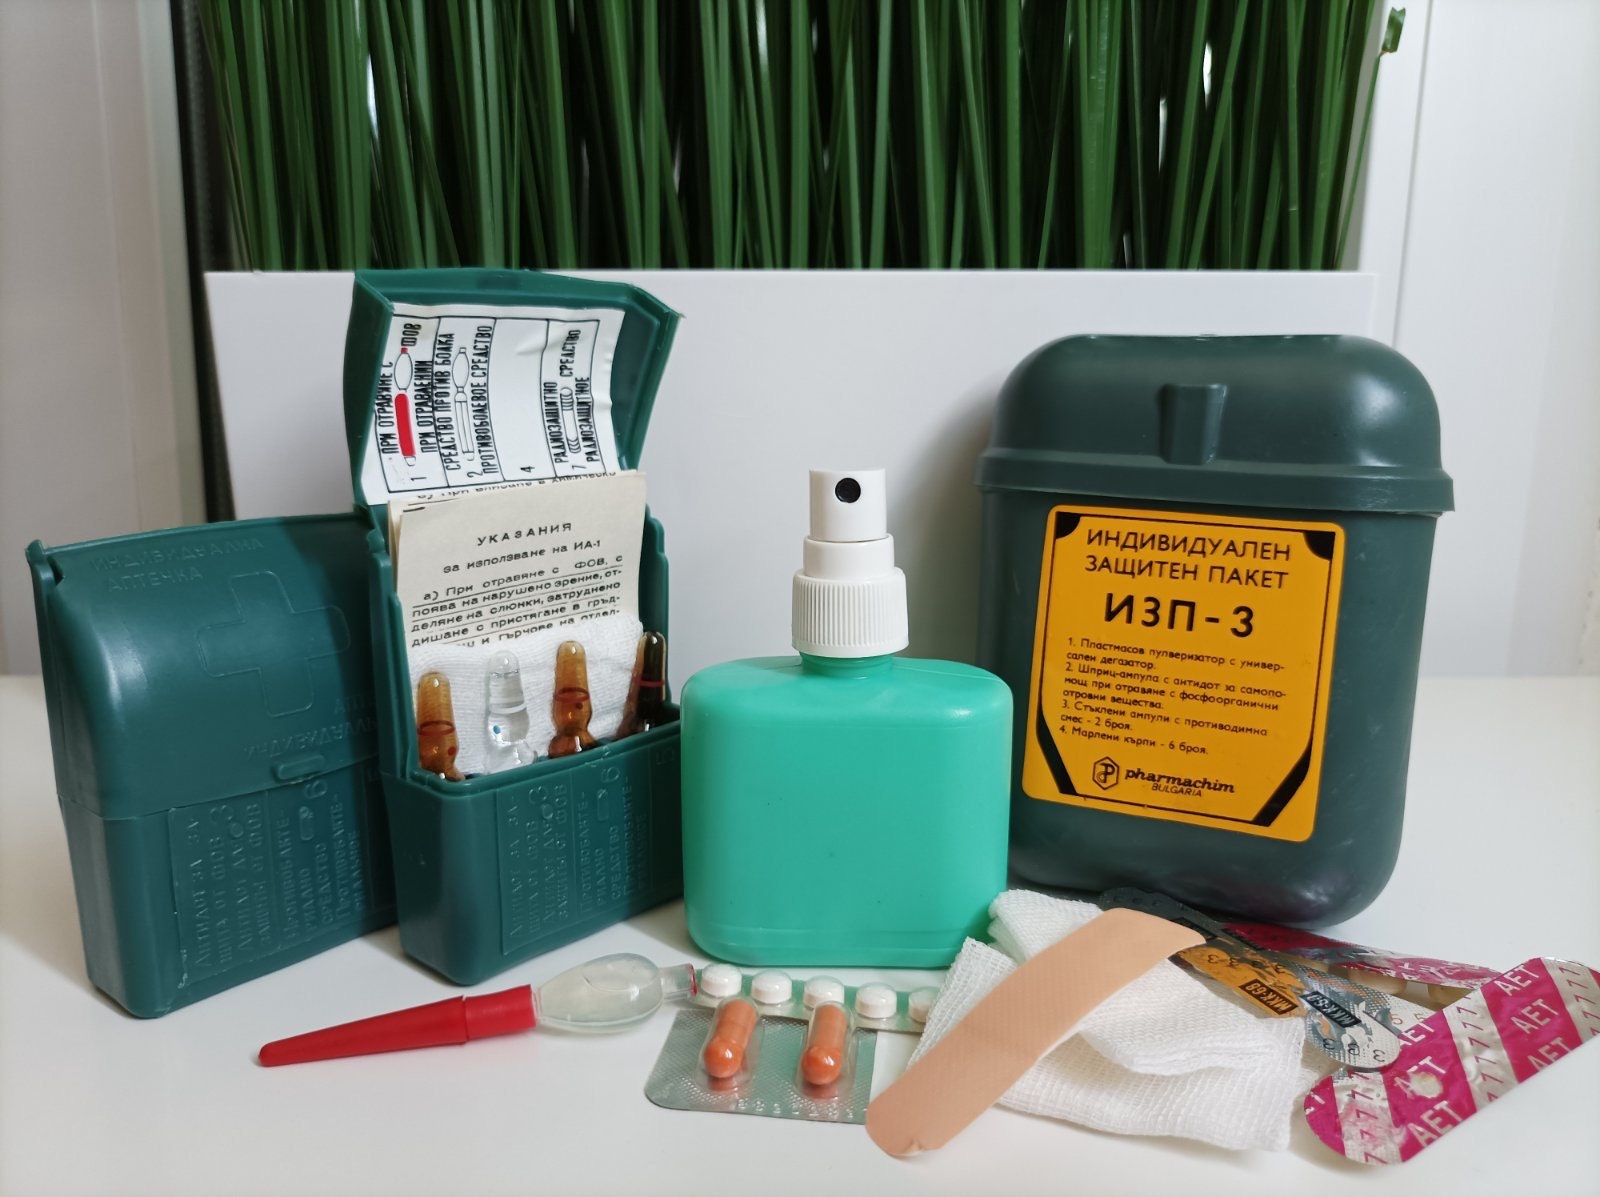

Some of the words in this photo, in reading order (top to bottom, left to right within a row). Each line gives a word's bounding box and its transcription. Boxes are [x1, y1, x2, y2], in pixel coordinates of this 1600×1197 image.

[435, 333, 455, 366] БОЛКА
[471, 325, 493, 378] СРЕДСТВО
[559, 329, 582, 377] СРЕДСТВО
[414, 360, 435, 428] ОТРАВЛЕНИИ
[434, 370, 452, 412] ПРОТИВ
[470, 381, 499, 474] ПРОТИВОБОЛЕВОЕ
[543, 381, 569, 464] РАДИОЗАЩИТНО
[575, 376, 601, 463] РАДИОЗАЩИТНОЕ
[379, 432, 400, 454] ПРИ
[418, 431, 438, 453] ПРИ
[436, 416, 462, 471] СРЕДСТВО
[520, 465, 535, 473] 4
[477, 522, 572, 547] УКАЗАНИЯ
[1086, 528, 1291, 561] ИНДИВИДУАЛЕН
[443, 564, 460, 574] за
[467, 548, 546, 570] използване
[552, 545, 568, 554] на
[574, 540, 601, 551] ИА-1
[1084, 555, 1199, 580] ЗАЩИТЕН
[1208, 565, 1289, 589] ПАКЕТ
[412, 602, 457, 617] поява
[462, 597, 479, 607] на
[482, 582, 552, 603] нарушено
[554, 572, 603, 588] зрение,
[604, 568, 622, 578] от-
[424, 591, 439, 601] а)
[446, 585, 474, 597] При
[482, 570, 545, 588] отравяне
[411, 614, 463, 633] деляне
[466, 610, 483, 621] на
[490, 598, 544, 615] слюнки,
[546, 581, 621, 603] затруднено
[411, 627, 469, 648] дишане
[476, 624, 484, 632] с
[490, 606, 566, 629] пристягане
[572, 603, 580, 611] в
[588, 595, 620, 608] гръд-
[1066, 652, 1096, 662] сален
[1100, 656, 1156, 671] дегазатор.
[1068, 637, 1077, 647] 1.
[1080, 638, 1145, 655] Пластмасов
[1149, 648, 1225, 666] пулверизатор
[1240, 659, 1285, 673] универ-
[1064, 677, 1088, 687] мощ
[1092, 680, 1111, 690] при
[1115, 683, 1166, 697] отравяне
[1169, 690, 1176, 698] с
[1179, 690, 1279, 711] фосфоорганични
[1065, 662, 1074, 672] 2.
[1078, 664, 1159, 683] Шприц-ампула
[1173, 677, 1220, 690] антидот
[1225, 684, 1236, 692] за
[1240, 686, 1286, 698] самопо-
[1063, 689, 1106, 701] отровни
[1111, 696, 1164, 710] вещества.
[1060, 714, 1083, 724] смес
[1095, 716, 1101, 726] 2
[1105, 718, 1133, 731] броя.
[1062, 698, 1070, 709] 3.
[1074, 701, 1126, 716] Стъклени
[1130, 711, 1170, 723] ампули
[1174, 717, 1180, 725] с
[1184, 718, 1267, 736] противодимна
[1059, 725, 1068, 734] 4.
[1072, 726, 1120, 741] Марлени
[1124, 736, 1156, 748] кърпи
[1168, 740, 1175, 750] 6
[1179, 741, 1208, 754] броя.
[1124, 768, 1235, 794] pharmachim
[1151, 782, 1202, 797] BULGARIA
[1394, 1055, 1447, 1100] AT
